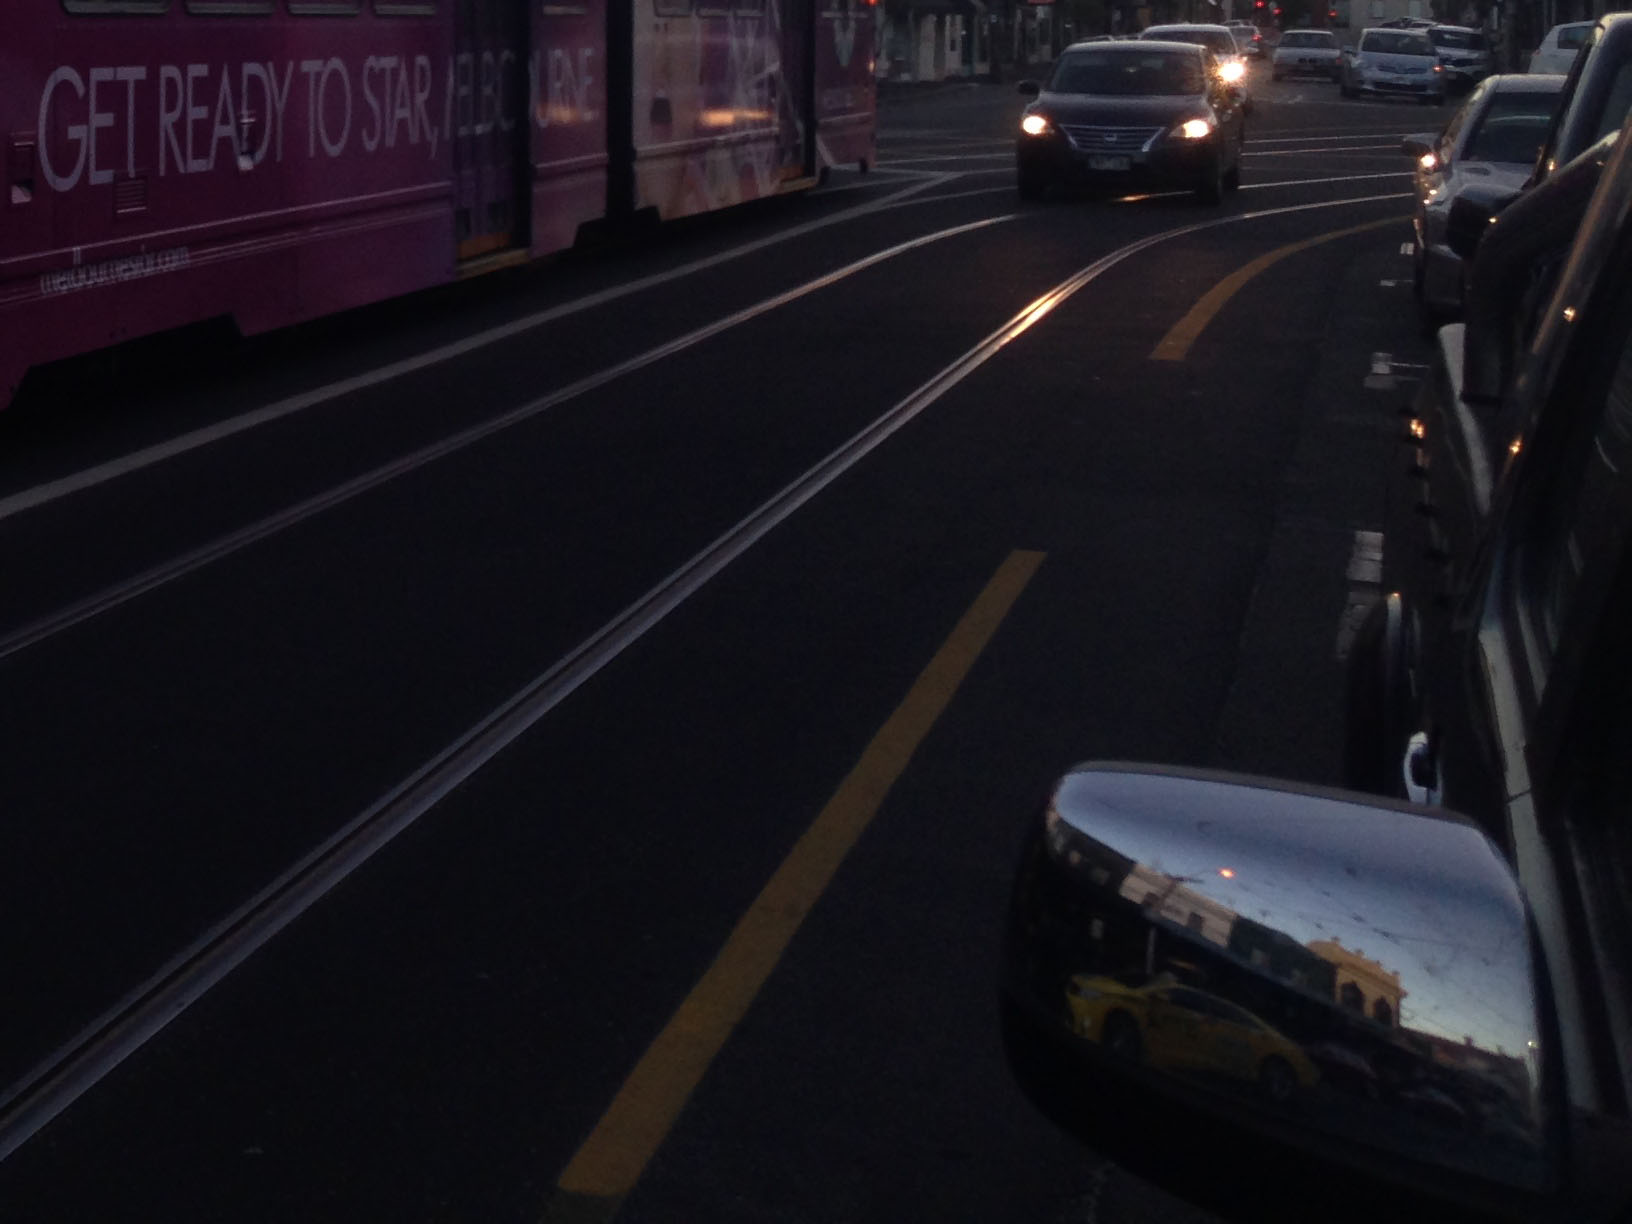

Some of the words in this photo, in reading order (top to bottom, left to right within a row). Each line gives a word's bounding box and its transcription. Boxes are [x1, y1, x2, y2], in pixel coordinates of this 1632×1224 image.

[38, 64, 148, 192] GET
[159, 59, 295, 176] READY
[301, 56, 352, 158] TO
[362, 54, 439, 160] STAR,
